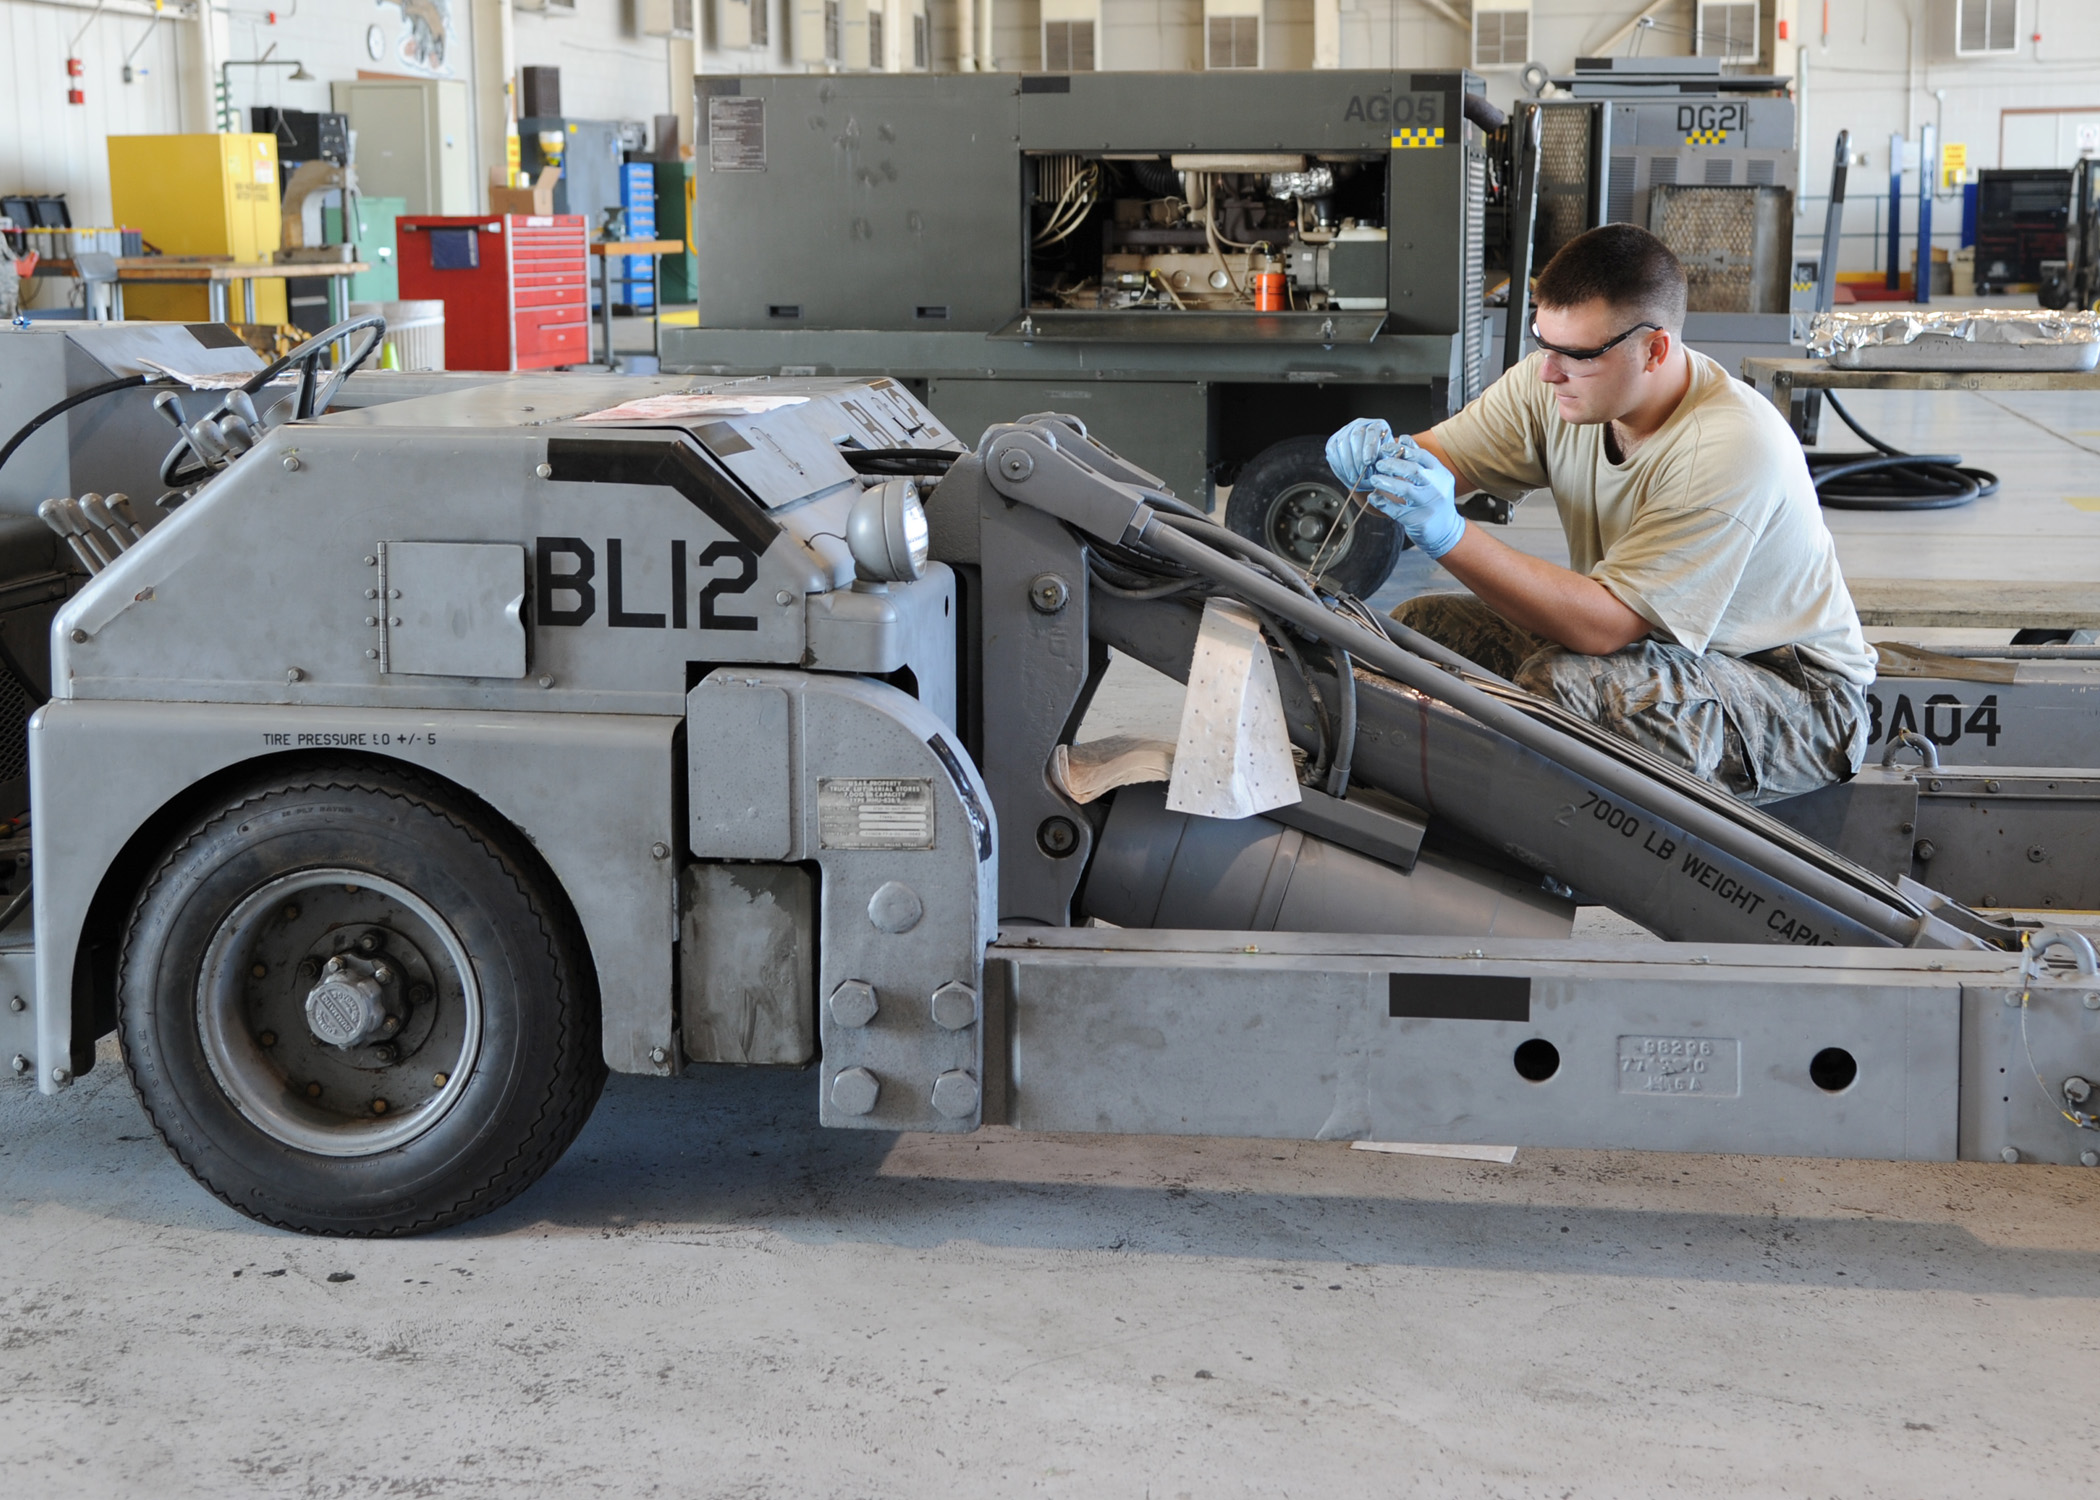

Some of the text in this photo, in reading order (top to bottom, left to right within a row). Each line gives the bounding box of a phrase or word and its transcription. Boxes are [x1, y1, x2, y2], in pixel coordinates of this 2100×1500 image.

[1677, 105, 1744, 131] DG21
[536, 536, 759, 631] BL12
[263, 733, 292, 746] TIRE
[298, 733, 367, 746] PRESSURE
[428, 733, 437, 746] 5
[1579, 791, 1640, 838] 7000
[1643, 830, 1677, 861] LB
[1681, 852, 1766, 916] WEIGHT
